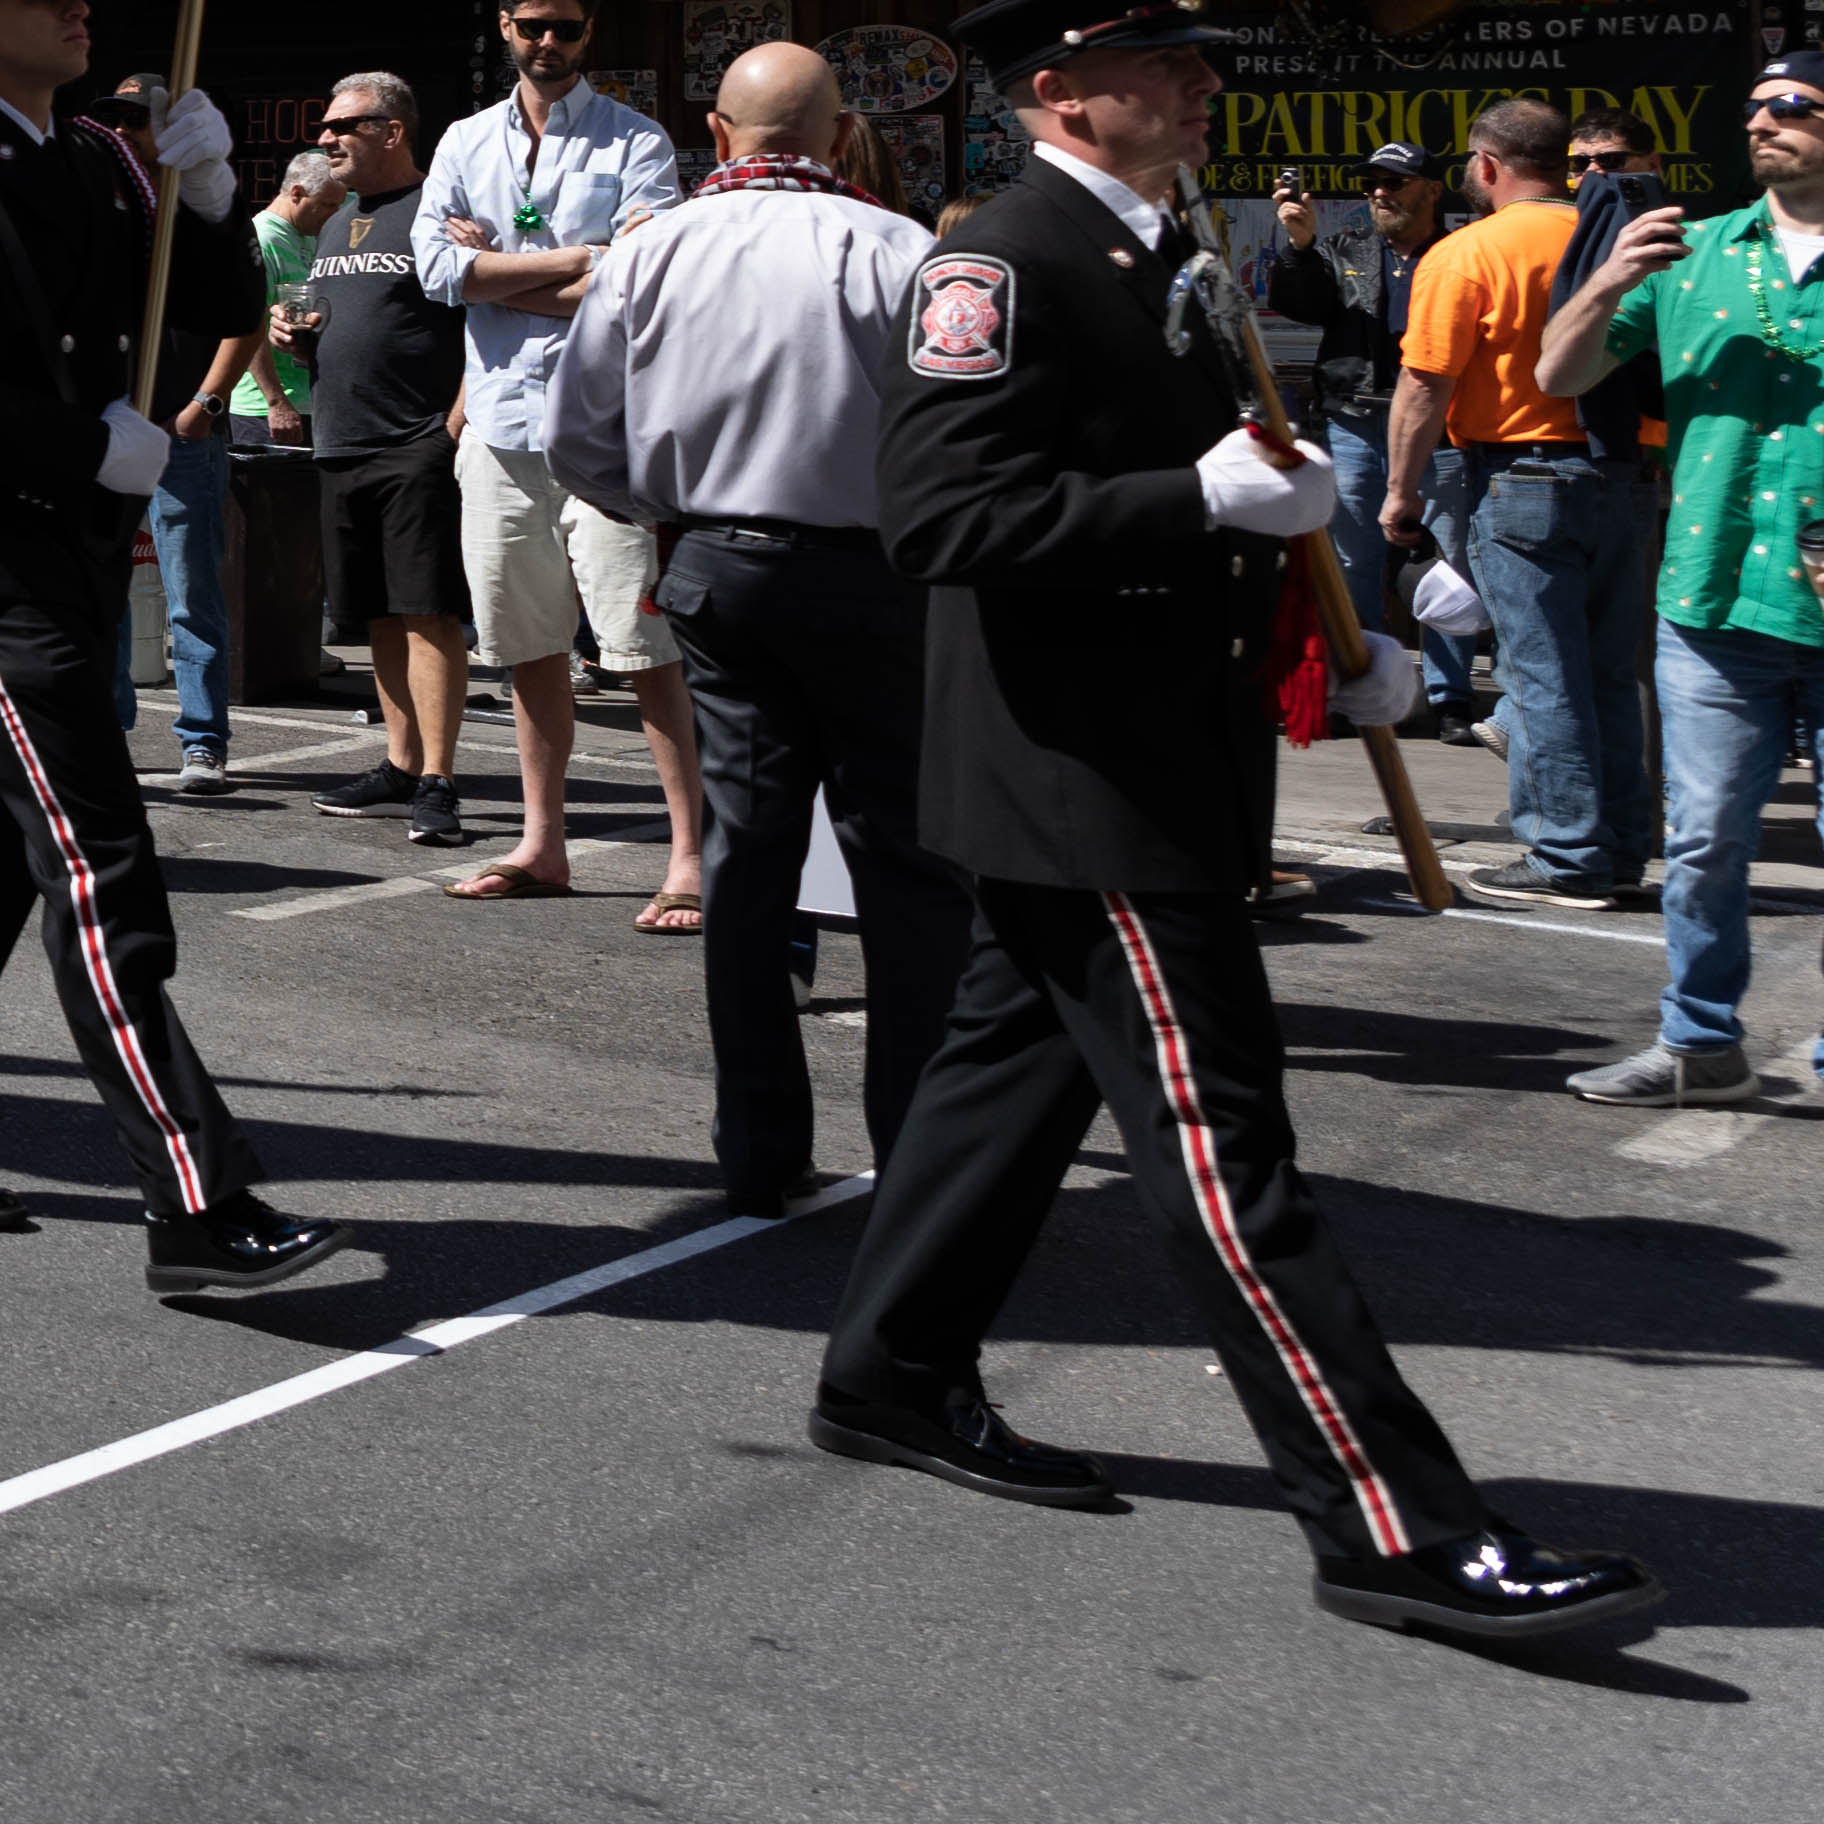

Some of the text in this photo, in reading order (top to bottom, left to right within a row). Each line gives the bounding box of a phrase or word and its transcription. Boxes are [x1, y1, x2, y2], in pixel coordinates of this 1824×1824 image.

[1544, 18, 1586, 39] OF
[1597, 12, 1735, 37] NEVADA
[1437, 48, 1568, 71] ANNUAL
[242, 98, 326, 144] HOG
[1220, 86, 1551, 159] PATRICK'
[1229, 163, 1252, 192] &
